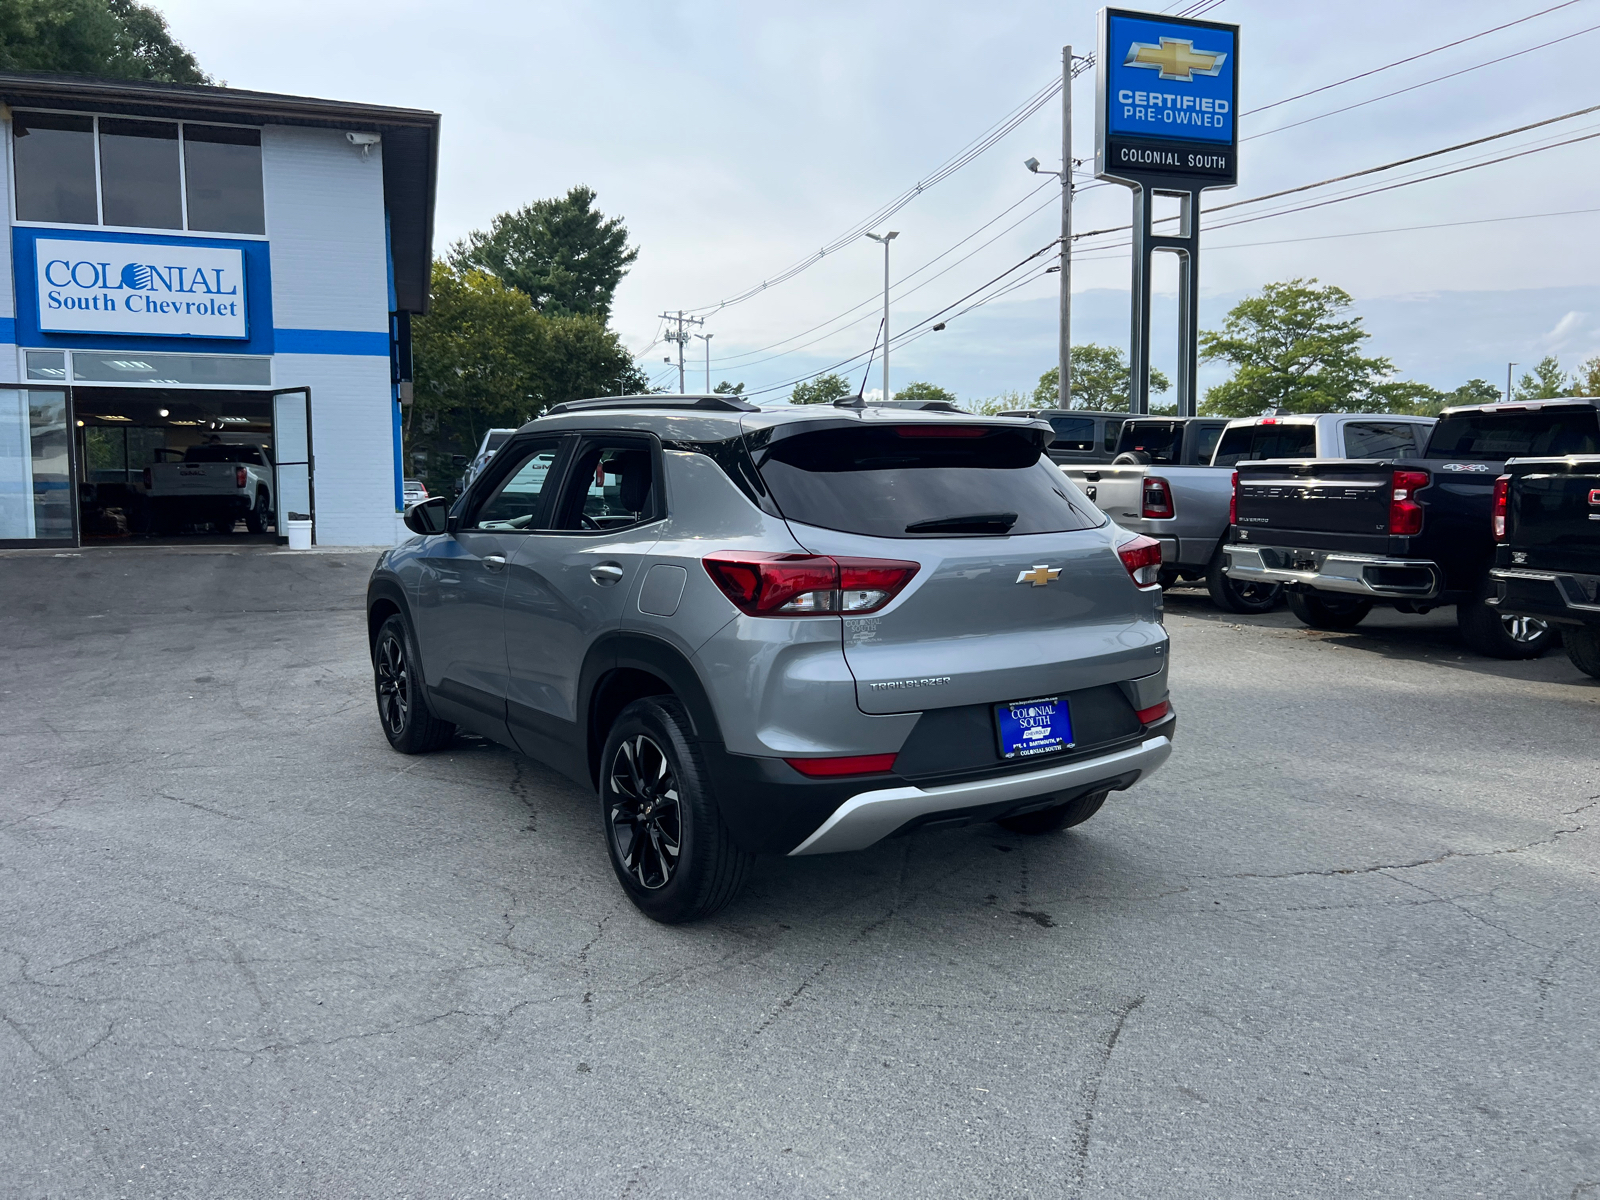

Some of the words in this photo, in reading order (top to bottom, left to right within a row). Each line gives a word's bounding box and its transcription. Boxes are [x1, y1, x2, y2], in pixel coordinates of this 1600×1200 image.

[1118, 90, 1229, 113] CERTIFIED
[1124, 106, 1223, 128] PRE-OWNED
[1121, 148, 1180, 166] COLONIAL
[1188, 154, 1225, 169] SOUTH
[45, 259, 237, 295] COLONIAL
[48, 290, 116, 312] South
[125, 294, 238, 317] Chevrolet
[1242, 487, 1376, 500] CHEVROLET
[845, 618, 882, 627] COLONIAL
[870, 677, 951, 691] TRAILBLAZER
[1011, 705, 1055, 719] COLONIAL
[1020, 716, 1051, 728] SOUTH
[1025, 729, 1049, 737] CHEVROLET
[1020, 748, 1045, 756] COLONIAL
[1045, 745, 1062, 753] SOUTH
